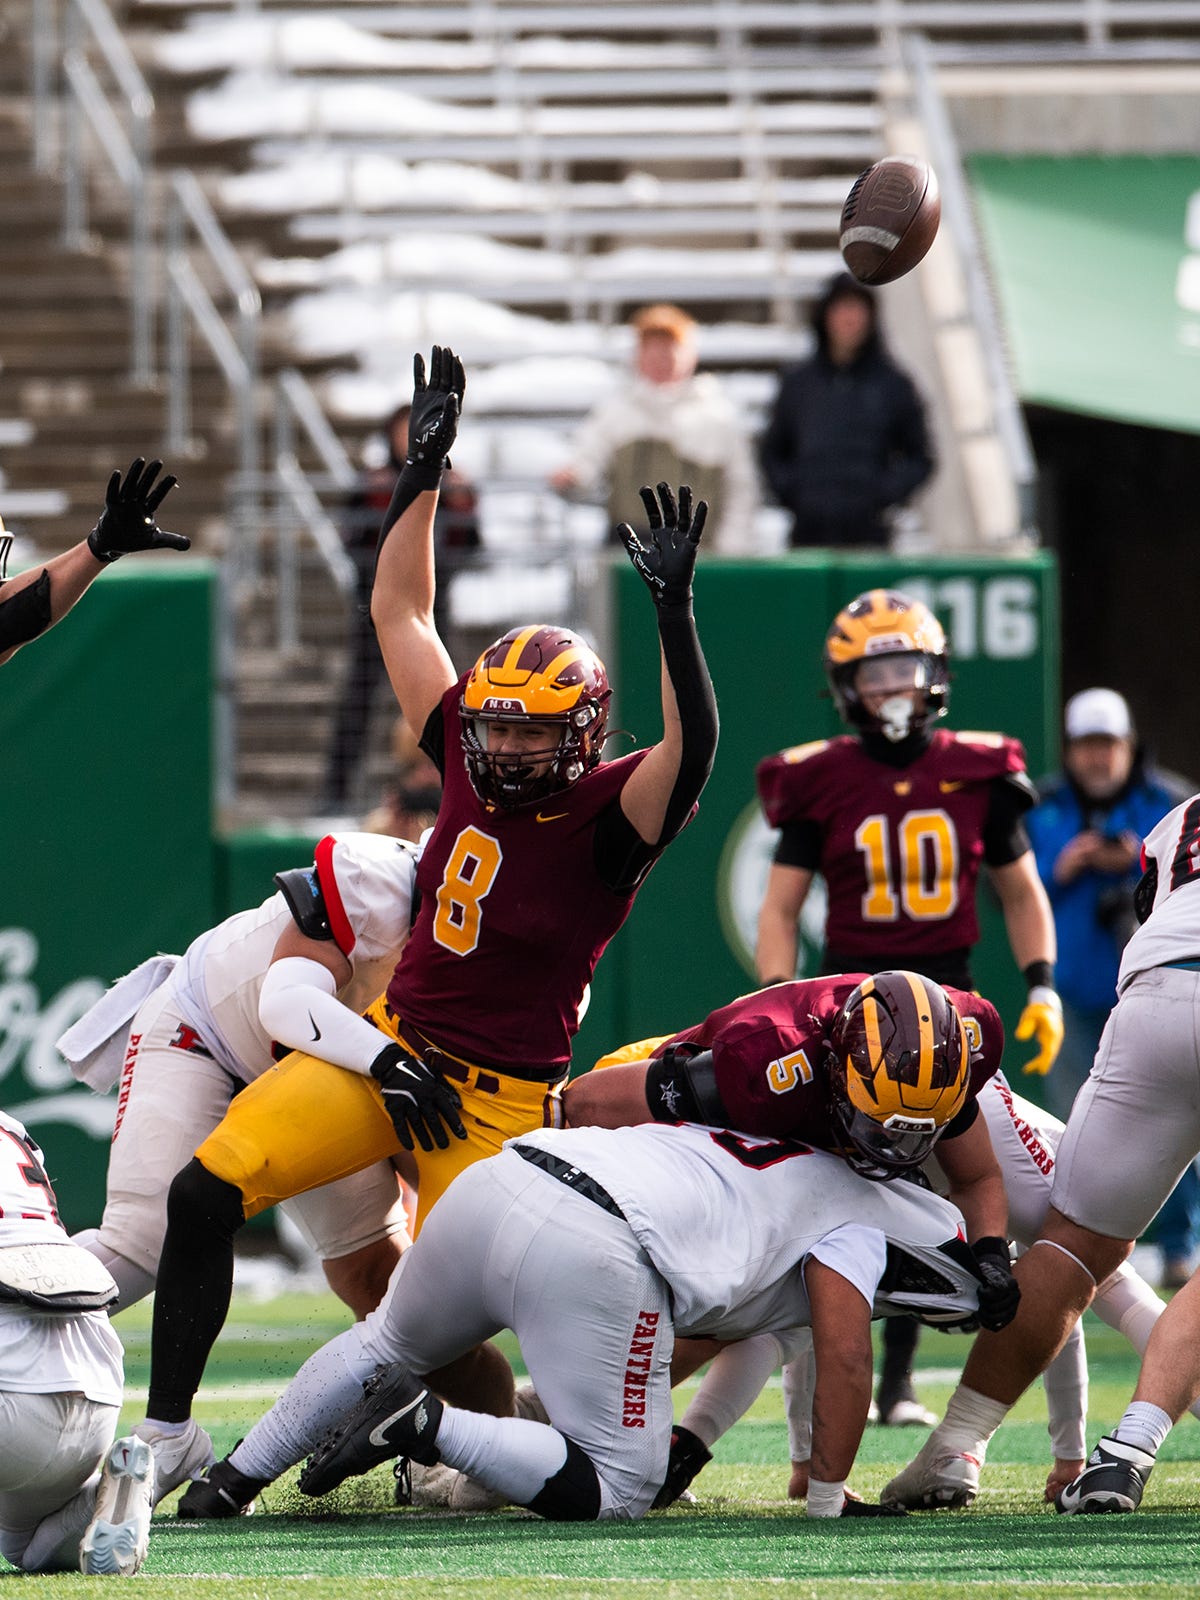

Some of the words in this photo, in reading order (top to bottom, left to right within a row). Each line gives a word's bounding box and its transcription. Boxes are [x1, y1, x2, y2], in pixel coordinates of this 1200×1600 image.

[433, 824, 503, 957] 8
[855, 808, 958, 922] 10
[765, 1048, 814, 1096] 5
[993, 1083, 1055, 1176] PANTHERS
[621, 1310, 660, 1429] PANTHERS
